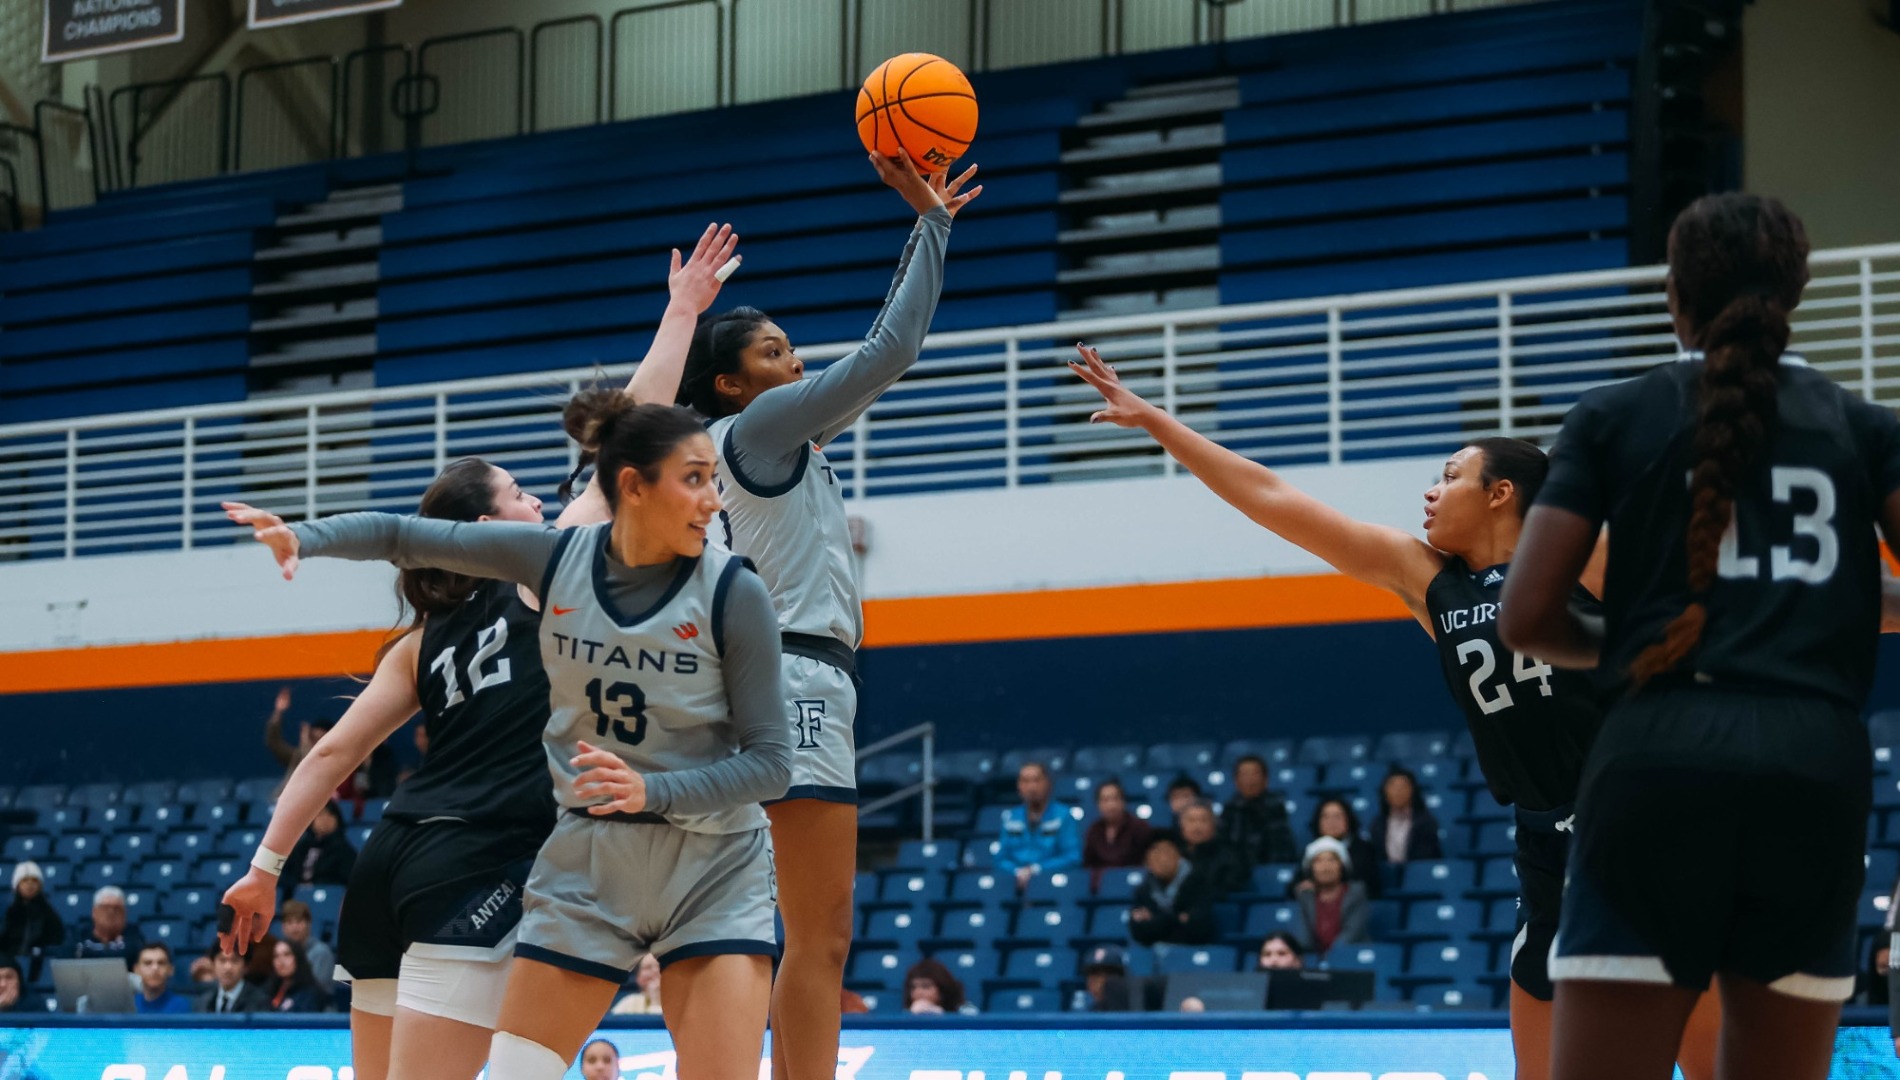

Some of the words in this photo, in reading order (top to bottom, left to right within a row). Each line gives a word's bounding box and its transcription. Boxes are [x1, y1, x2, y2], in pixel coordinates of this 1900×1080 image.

[64, 6, 162, 41] CHAMPIONS
[1440, 609, 1469, 634] UC
[1472, 602, 1503, 625] IR
[430, 616, 512, 717] 12
[552, 632, 700, 675] TITANS
[1456, 638, 1553, 715] 24
[584, 676, 649, 747] 13
[792, 698, 827, 751] F
[470, 879, 517, 930] ANTEA
